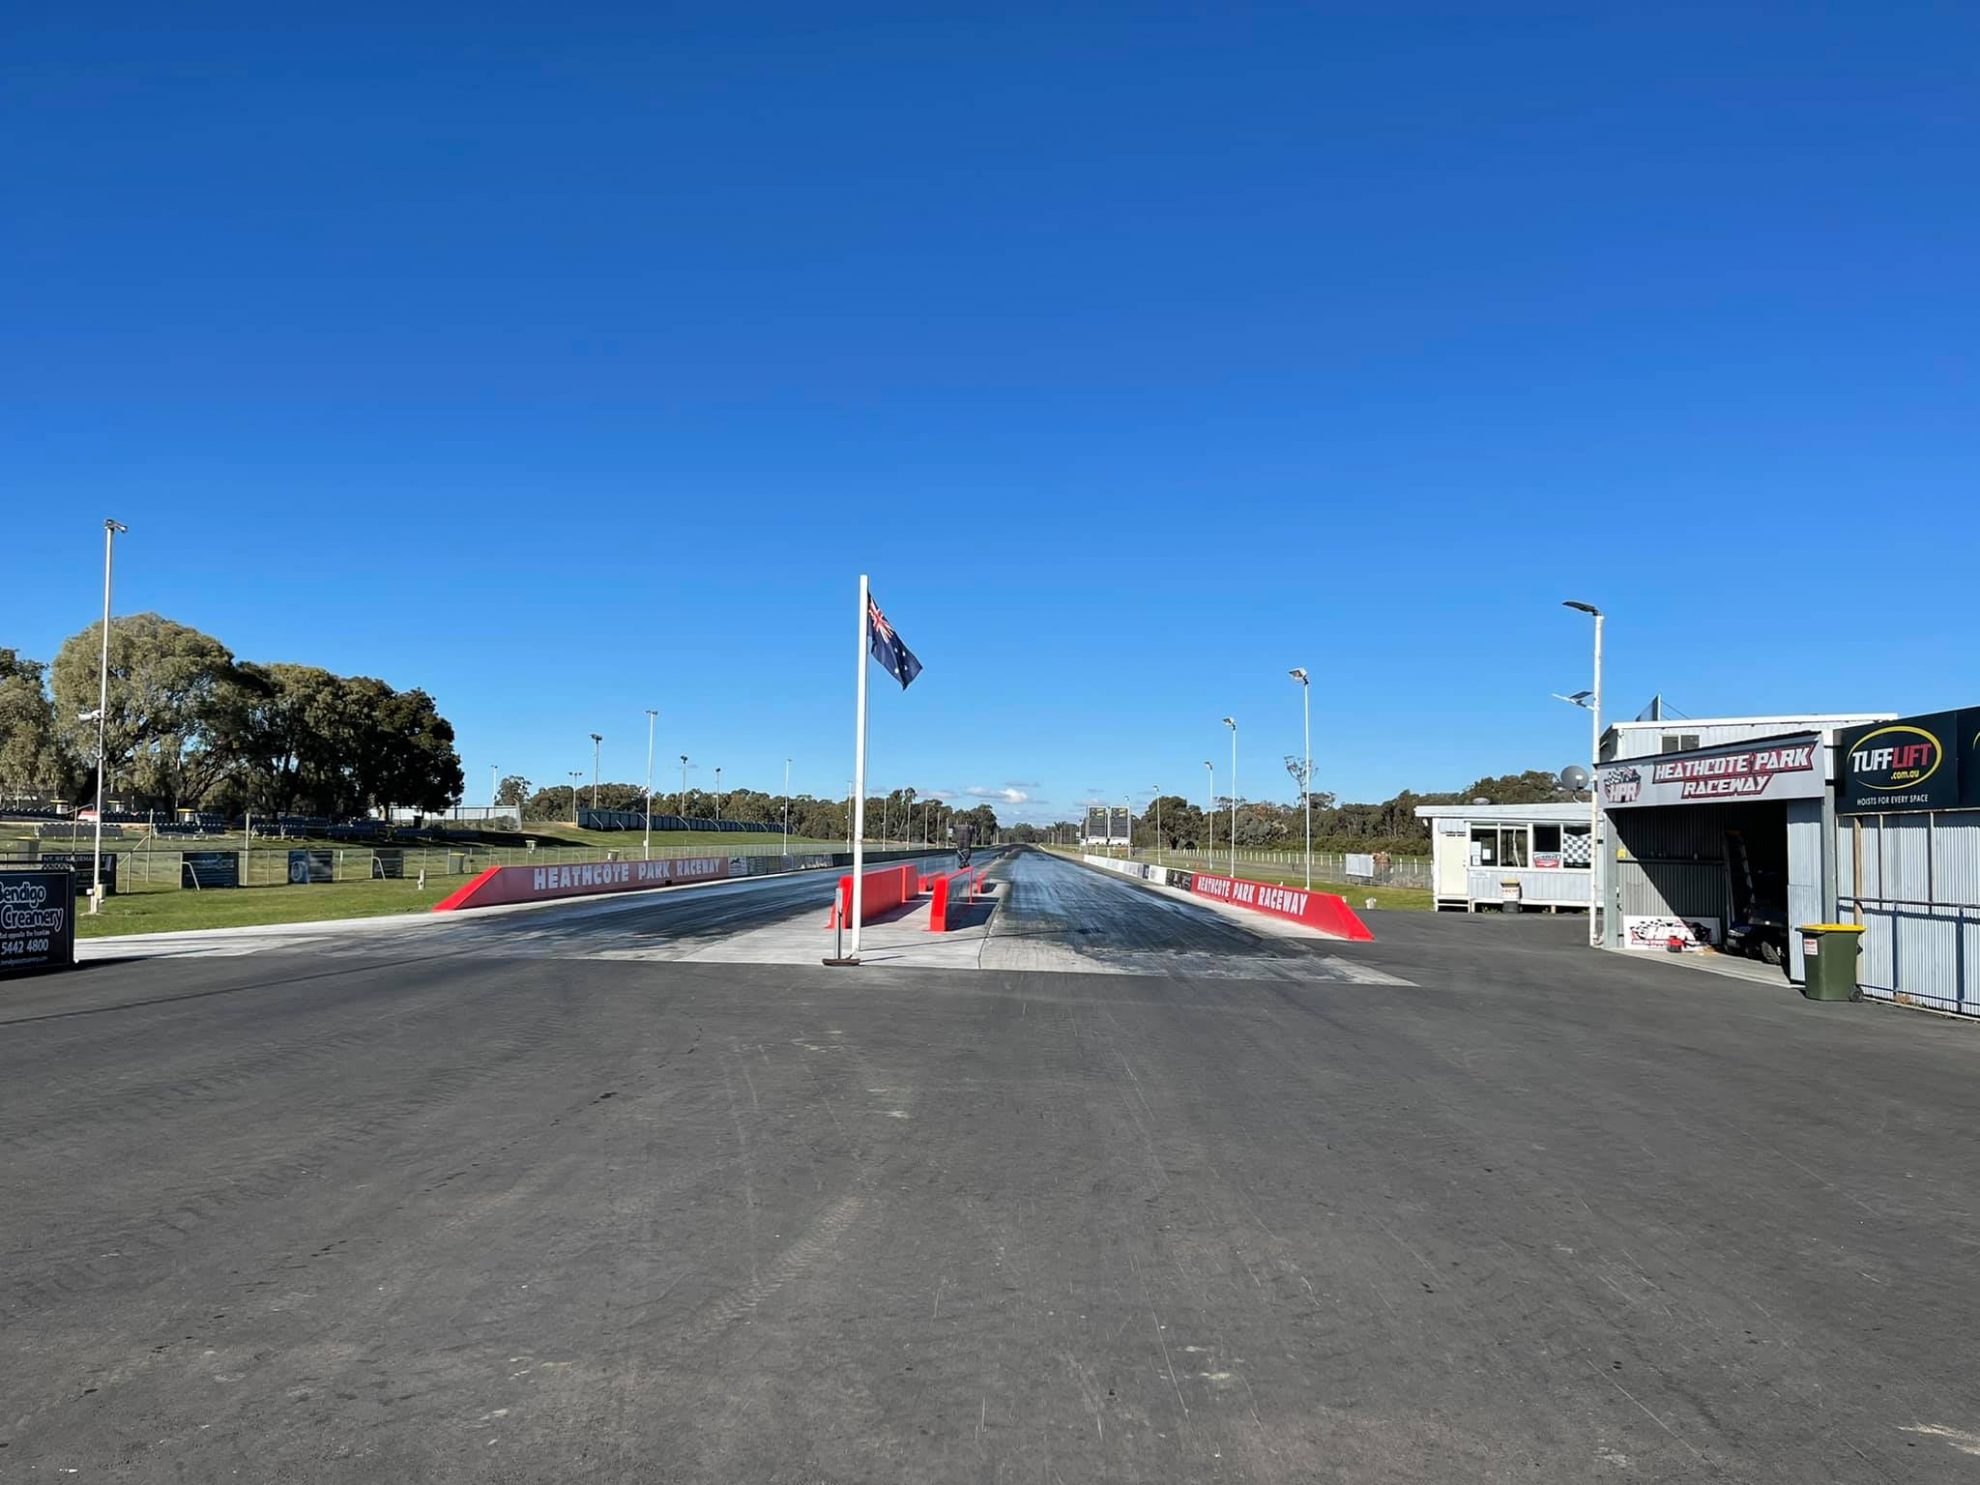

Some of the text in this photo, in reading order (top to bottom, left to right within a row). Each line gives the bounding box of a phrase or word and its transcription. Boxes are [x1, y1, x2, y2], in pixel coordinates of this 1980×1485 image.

[1655, 747, 1810, 780] HEATHCOTE PARK
[1890, 769, 1920, 780] .com.au
[1608, 781, 1639, 803] HPR
[1683, 774, 1769, 796] RACEWAY
[1857, 794, 1928, 806] HOISTS FOR EVERY SPACE
[533, 863, 630, 890] HEATHCOTE
[638, 860, 671, 880] PARK
[676, 857, 721, 877] RACEWAY
[1197, 876, 1308, 916] HEATHCOTE PARK RACEWAY
[1, 904, 64, 932] Creamery
[0, 938, 49, 956] 5442 4800
